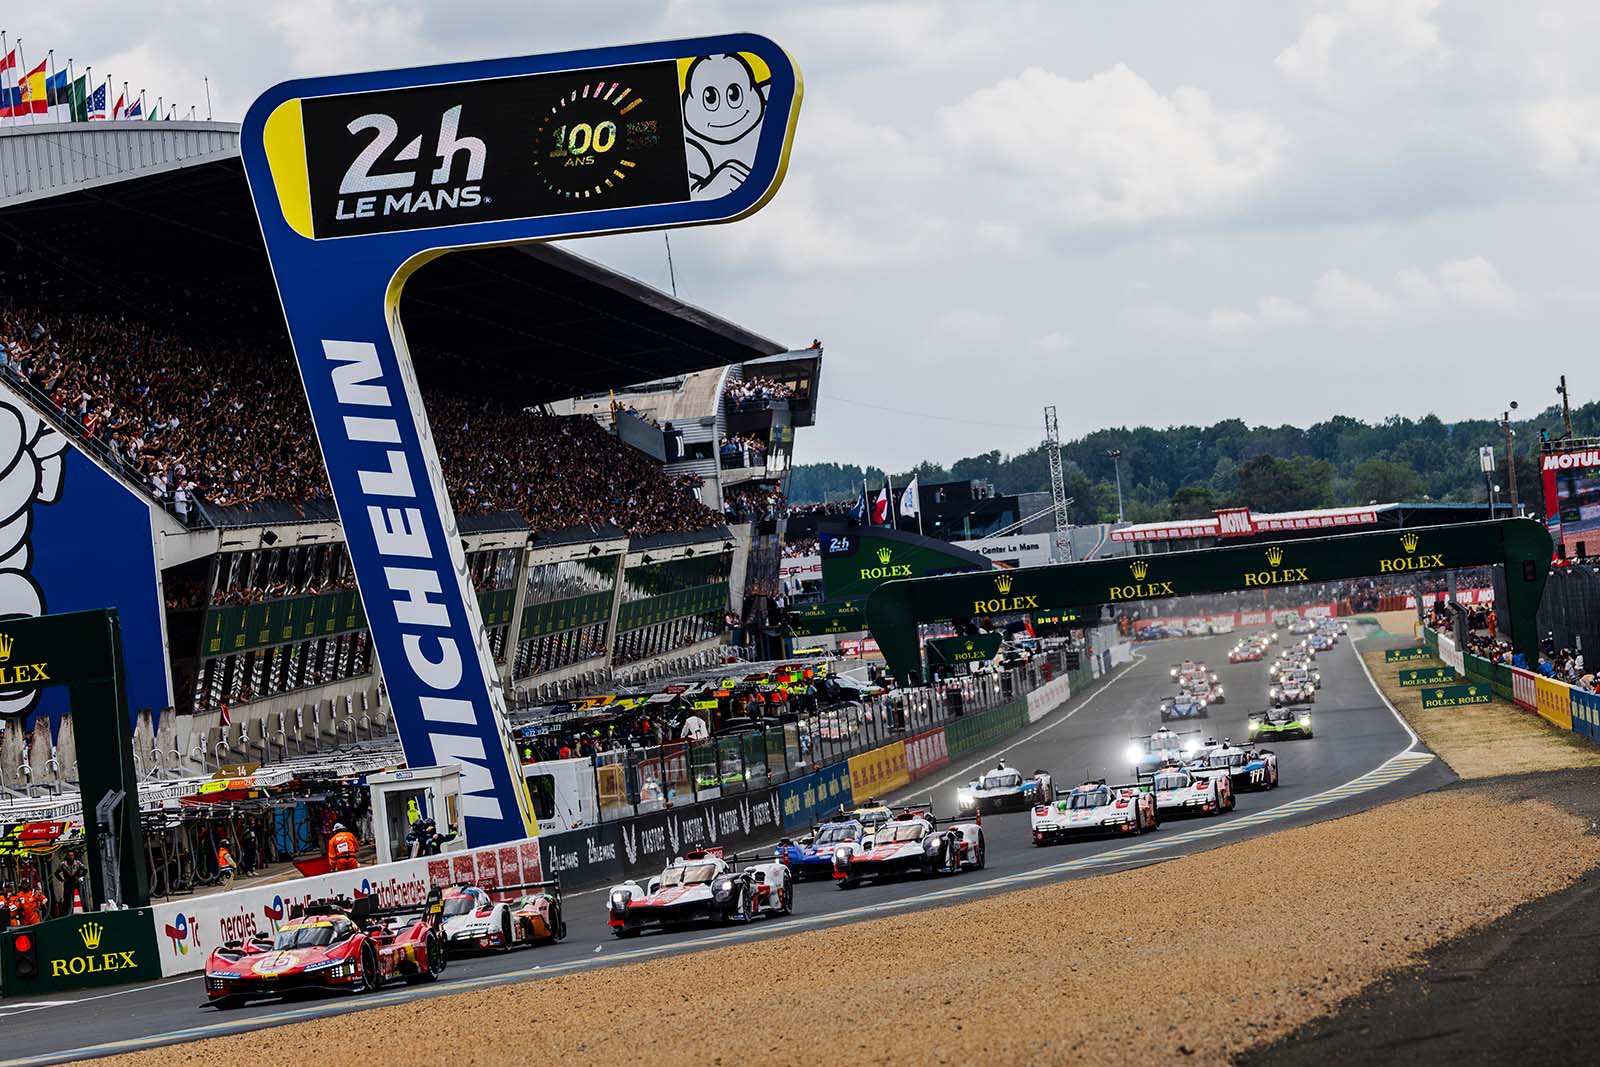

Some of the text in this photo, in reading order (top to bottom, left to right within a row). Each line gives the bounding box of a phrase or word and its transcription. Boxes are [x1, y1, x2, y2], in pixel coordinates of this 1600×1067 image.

[551, 121, 617, 156] 100
[339, 104, 486, 195] 24h
[564, 155, 595, 167] ANS
[336, 186, 481, 220] LE MANS
[1543, 451, 1600, 470] MOTUL
[1219, 511, 1252, 534] MOTUL
[1008, 544, 1017, 552] Le
[1020, 543, 1039, 551] Mans
[860, 564, 913, 579] ROLEX
[1380, 554, 1445, 572] ROLEX
[321, 339, 504, 820] MICHELIN
[1244, 568, 1309, 586] ROLEX
[1109, 582, 1174, 600] ROLEX
[974, 595, 1039, 614] ROLEX
[955, 650, 986, 660] ROLEX
[571, 703, 577, 711] 2
[1426, 695, 1488, 707] ROLEX ROLEX
[237, 765, 247, 776] 14
[49, 825, 59, 834] 31
[641, 826, 665, 854] CASTORE
[51, 951, 138, 977] ROLEX
